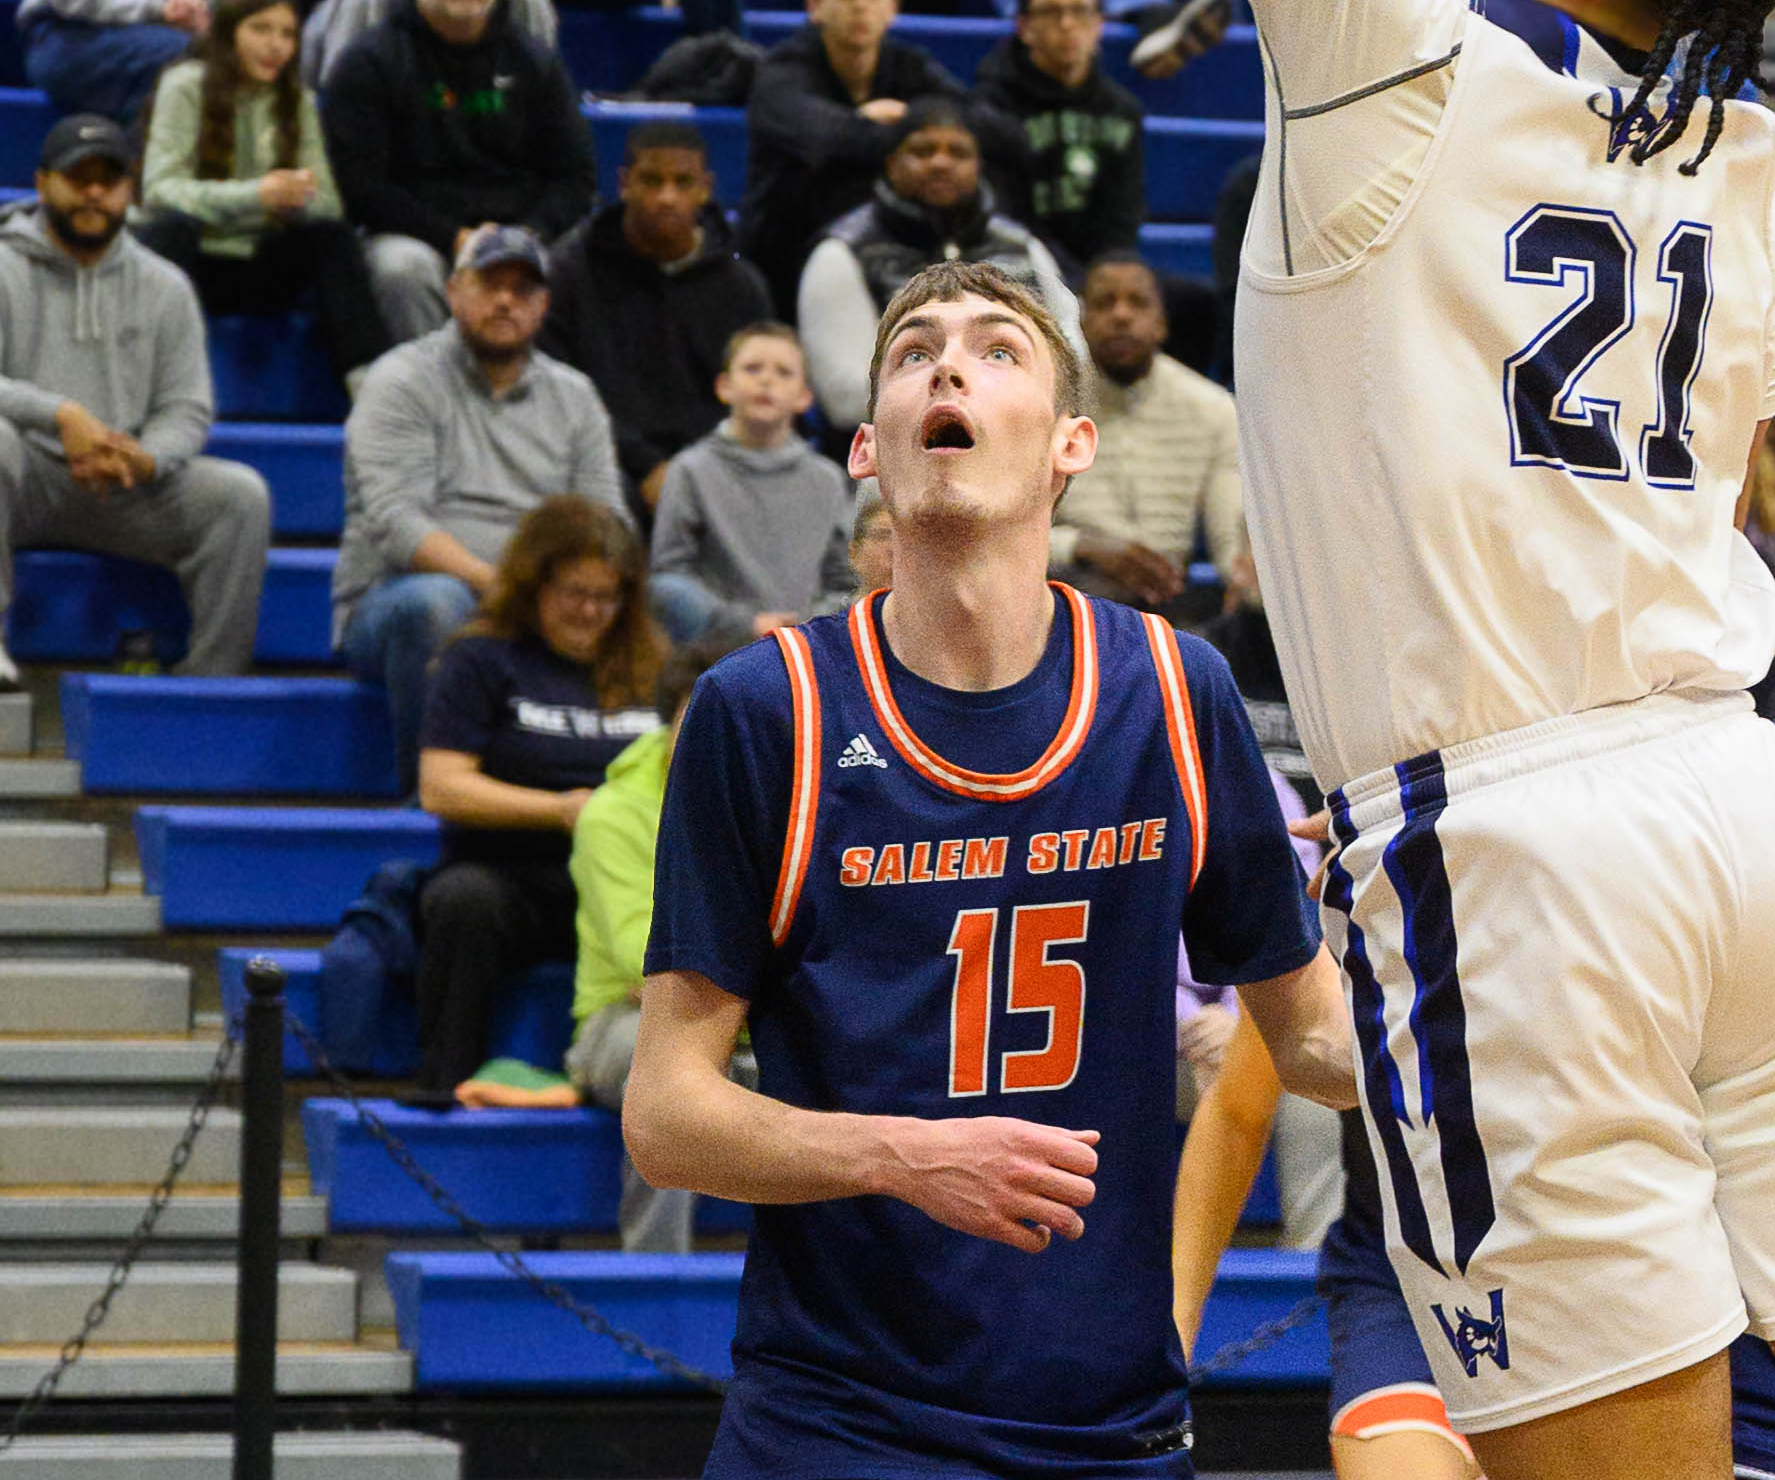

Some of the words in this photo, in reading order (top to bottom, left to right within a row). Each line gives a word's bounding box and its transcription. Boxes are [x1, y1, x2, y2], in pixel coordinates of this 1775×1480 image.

[1503, 202, 1714, 491] 21
[837, 753, 888, 770] adidas
[840, 836, 1010, 888] SALEM
[1027, 817, 1168, 875] STATE
[945, 900, 1091, 1099] 15
